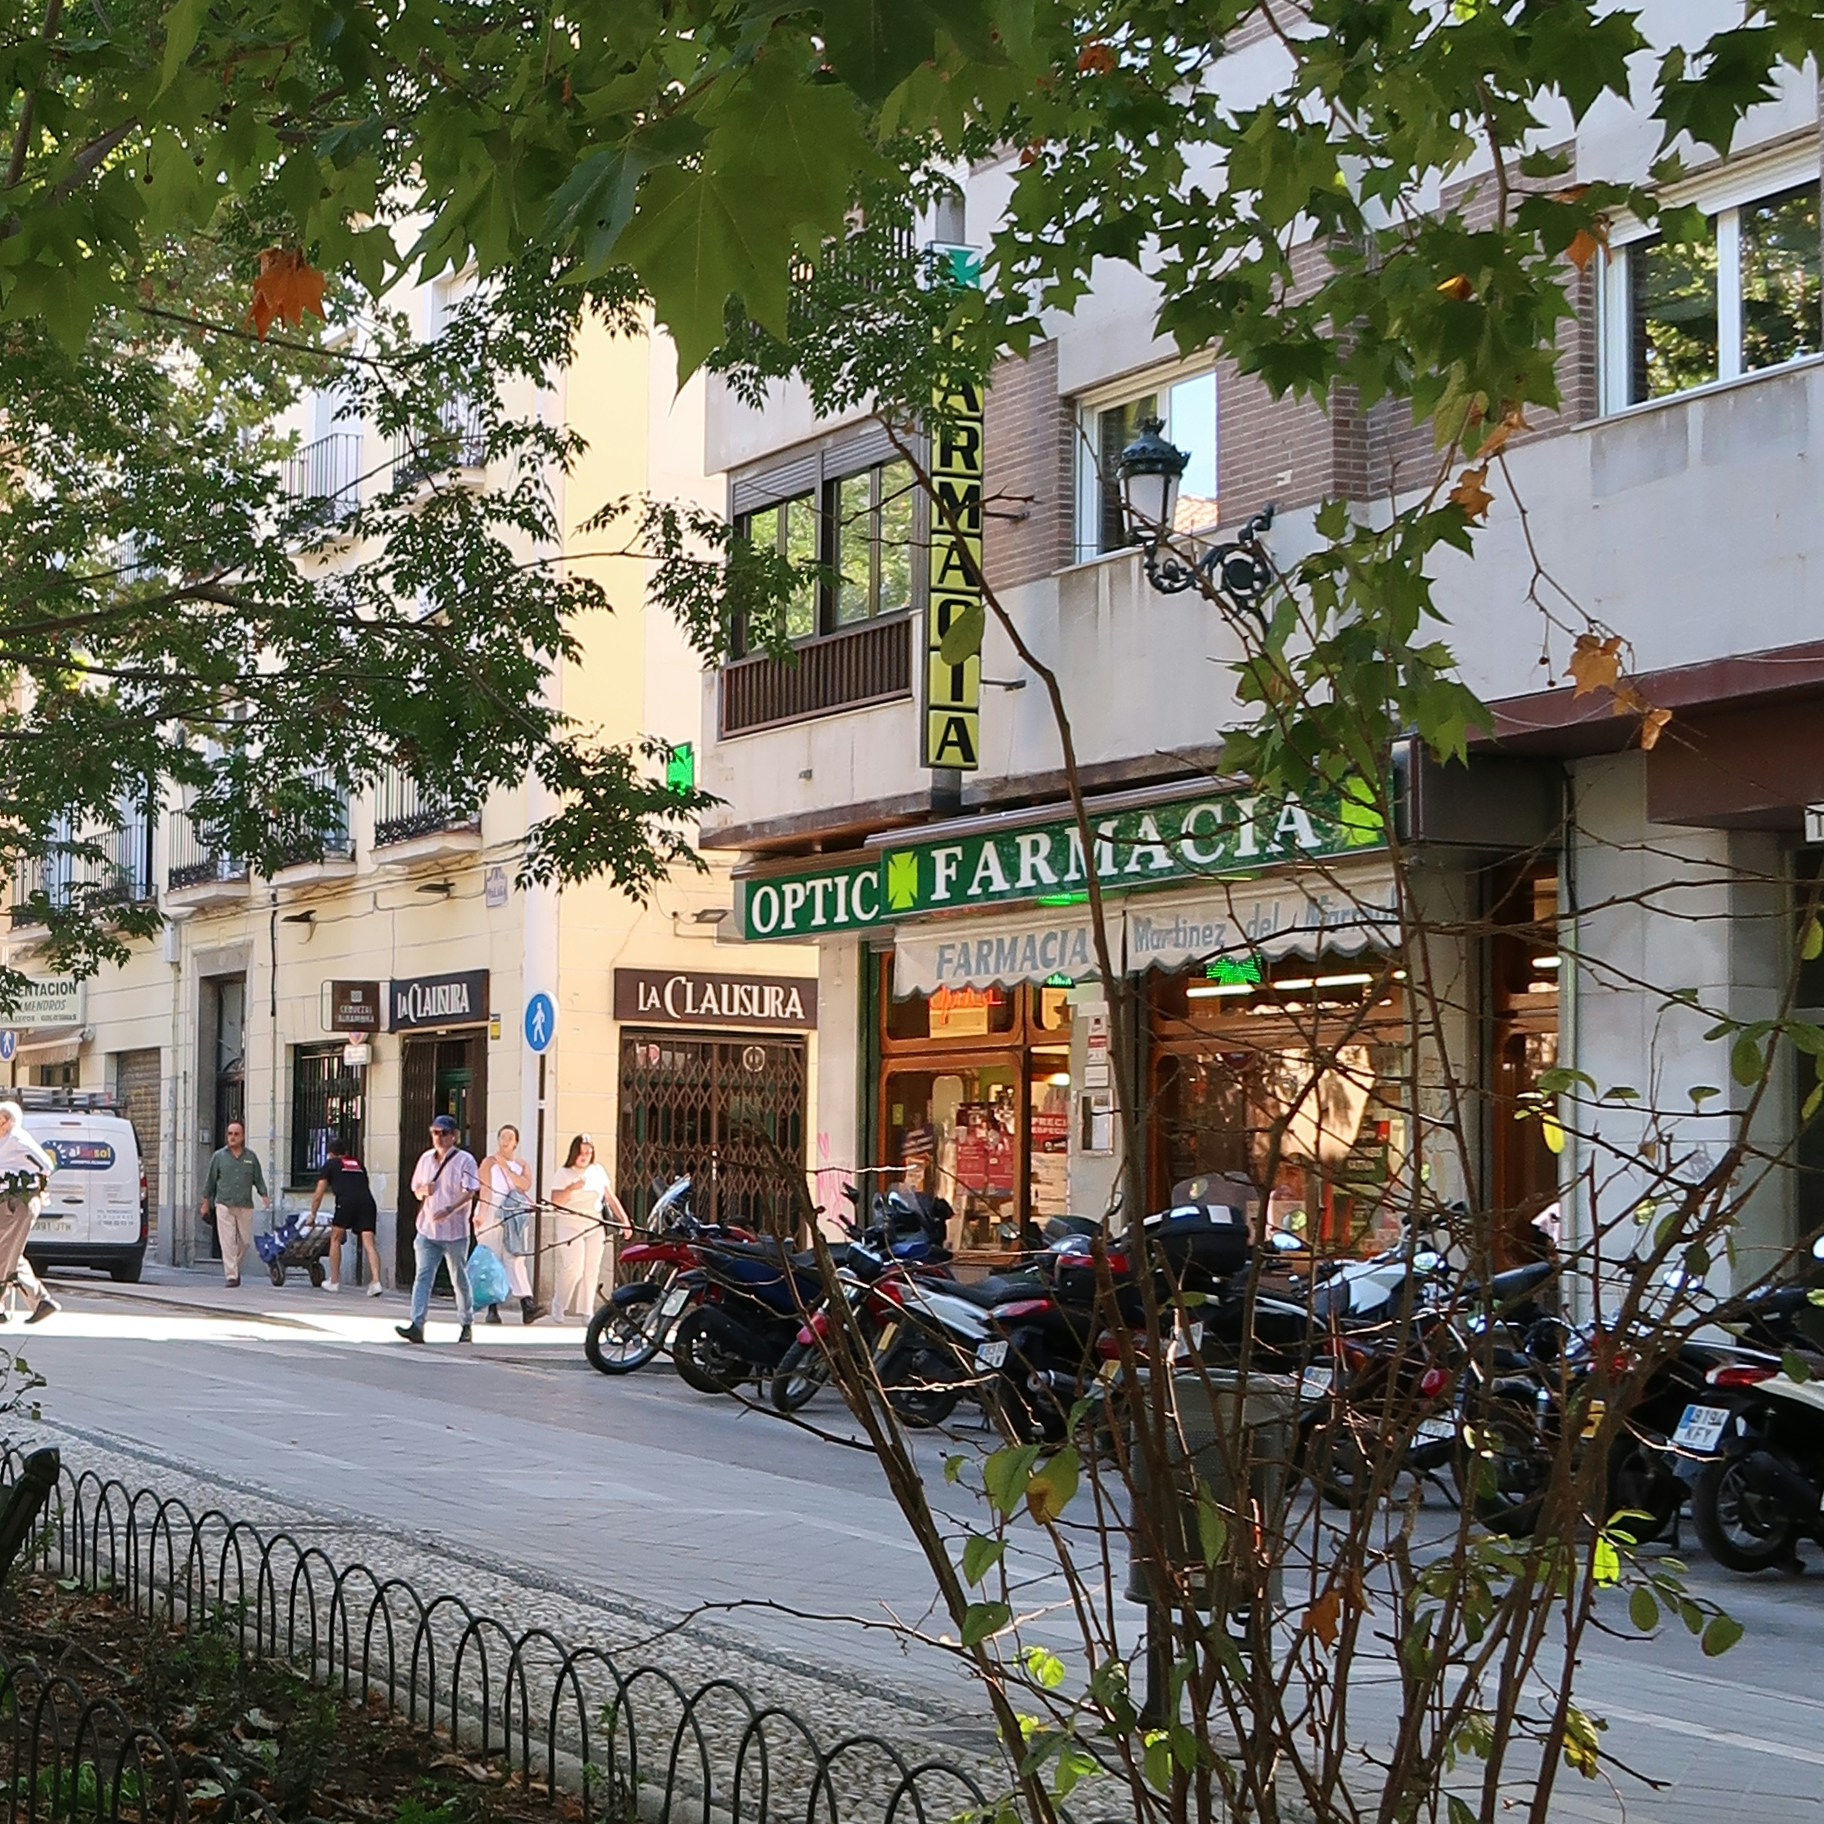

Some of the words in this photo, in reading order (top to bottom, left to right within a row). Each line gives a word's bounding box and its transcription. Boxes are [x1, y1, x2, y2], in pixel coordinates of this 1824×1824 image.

[933, 366, 980, 764] ARMACIA
[930, 791, 1322, 901] FARMACIA
[751, 871, 879, 933] OPTIC
[1246, 902, 1280, 939] del
[936, 928, 1089, 979] FARMACIA
[397, 992, 408, 1019] LA
[408, 983, 470, 1023] CLAUSURA
[638, 982, 661, 1011] LA
[664, 976, 806, 1019] CLAUSURA
[1031, 1117, 1066, 1127] PRECI
